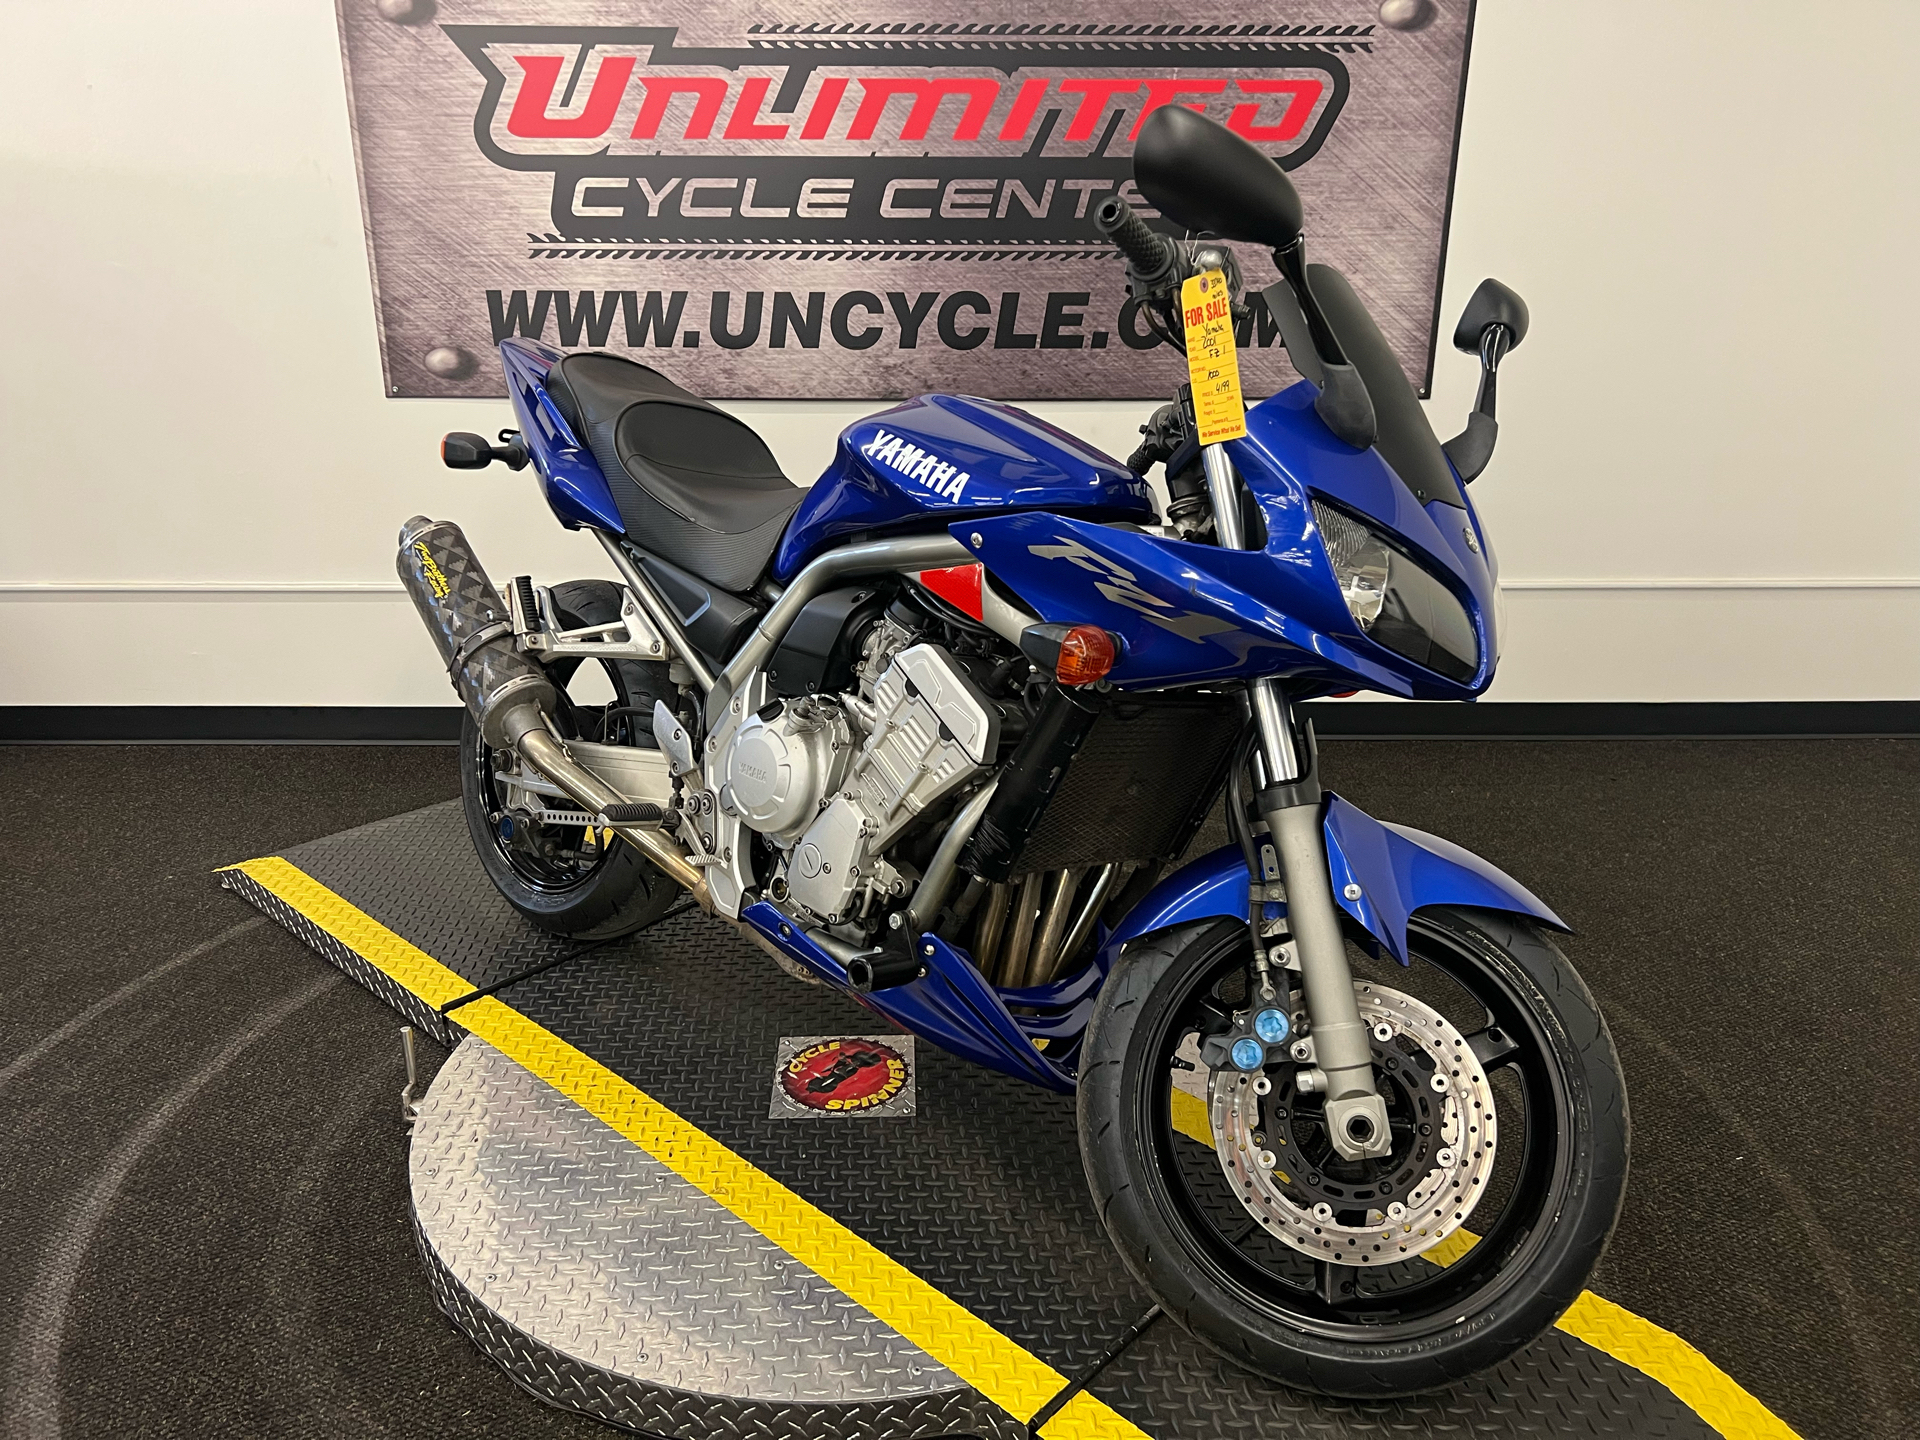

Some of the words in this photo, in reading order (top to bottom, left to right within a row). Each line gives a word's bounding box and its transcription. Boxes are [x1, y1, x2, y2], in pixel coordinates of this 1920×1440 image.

[570, 177, 855, 218] CYCLE
[1185, 306, 1205, 328] FOR
[1206, 297, 1228, 321] SALE
[1201, 336, 1217, 349] 2001
[1216, 380, 1230, 394] 4199
[867, 429, 971, 504] YAMAHA
[788, 1041, 841, 1073] CYCLE
[825, 1058, 905, 1110] SPINNER
